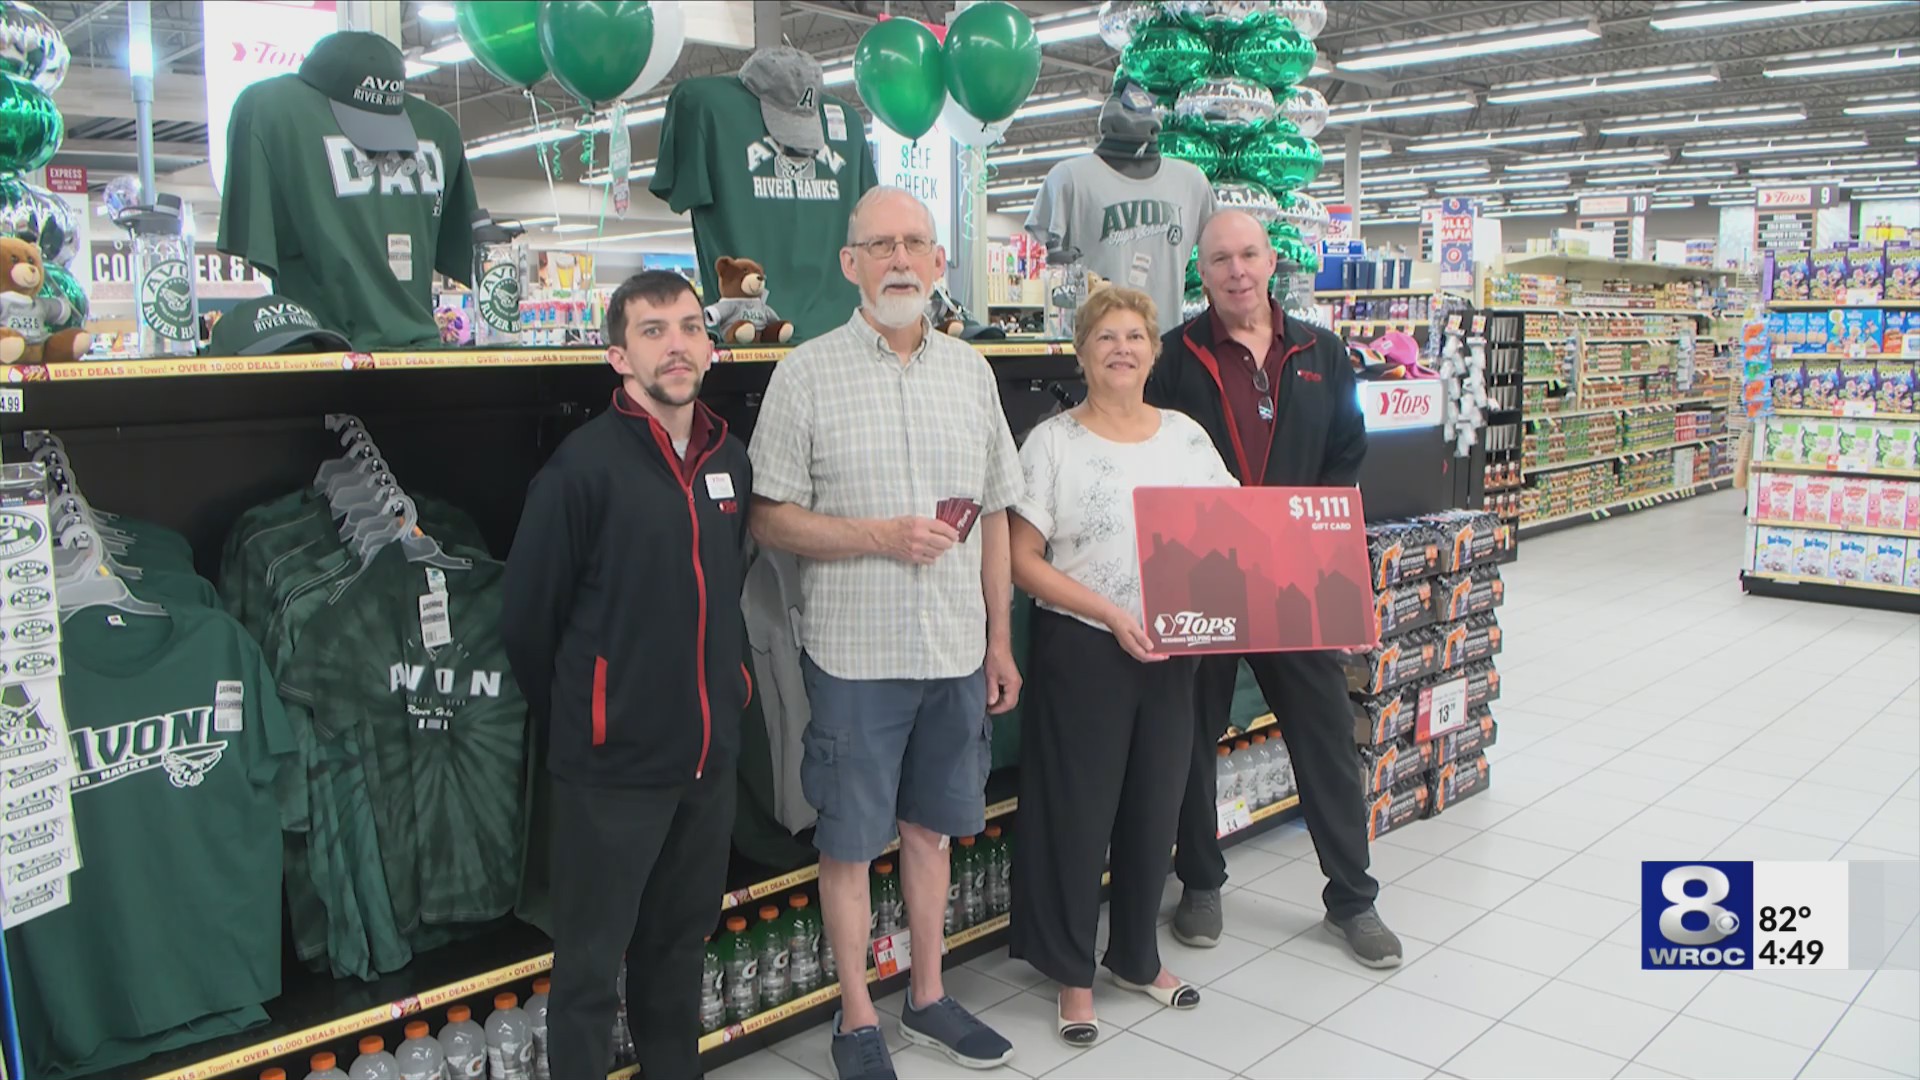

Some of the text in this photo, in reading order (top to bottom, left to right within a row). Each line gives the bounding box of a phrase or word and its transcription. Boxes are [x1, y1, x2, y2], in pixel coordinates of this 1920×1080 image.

[353, 88, 384, 104] RIVER
[901, 144, 931, 169] SELF
[50, 168, 82, 179] EXPRESS
[753, 176, 840, 200] RIVER HAWKS
[1821, 187, 1831, 204] 9
[1632, 195, 1647, 213] 10
[143, 304, 178, 339] RIVER
[253, 317, 288, 333] RIVER
[480, 302, 511, 332] RIVER
[55, 368, 83, 378] BEST
[88, 366, 124, 377] DEALS
[178, 363, 207, 373] OVER
[211, 362, 244, 373] 10,000
[248, 361, 281, 370] DEALS
[1289, 495, 1350, 521] $1,111
[1312, 522, 1351, 531] GIFT CARD
[390, 660, 502, 698] AVON
[1438, 704, 1449, 724] 13
[101, 758, 149, 781] HAWKS
[424, 993, 447, 1006] BEST
[449, 984, 477, 998] DEALS
[514, 963, 537, 977] OVER
[243, 1049, 269, 1064] OVER
[273, 1038, 303, 1055] 10,000
[305, 1029, 336, 1045] DEALS
